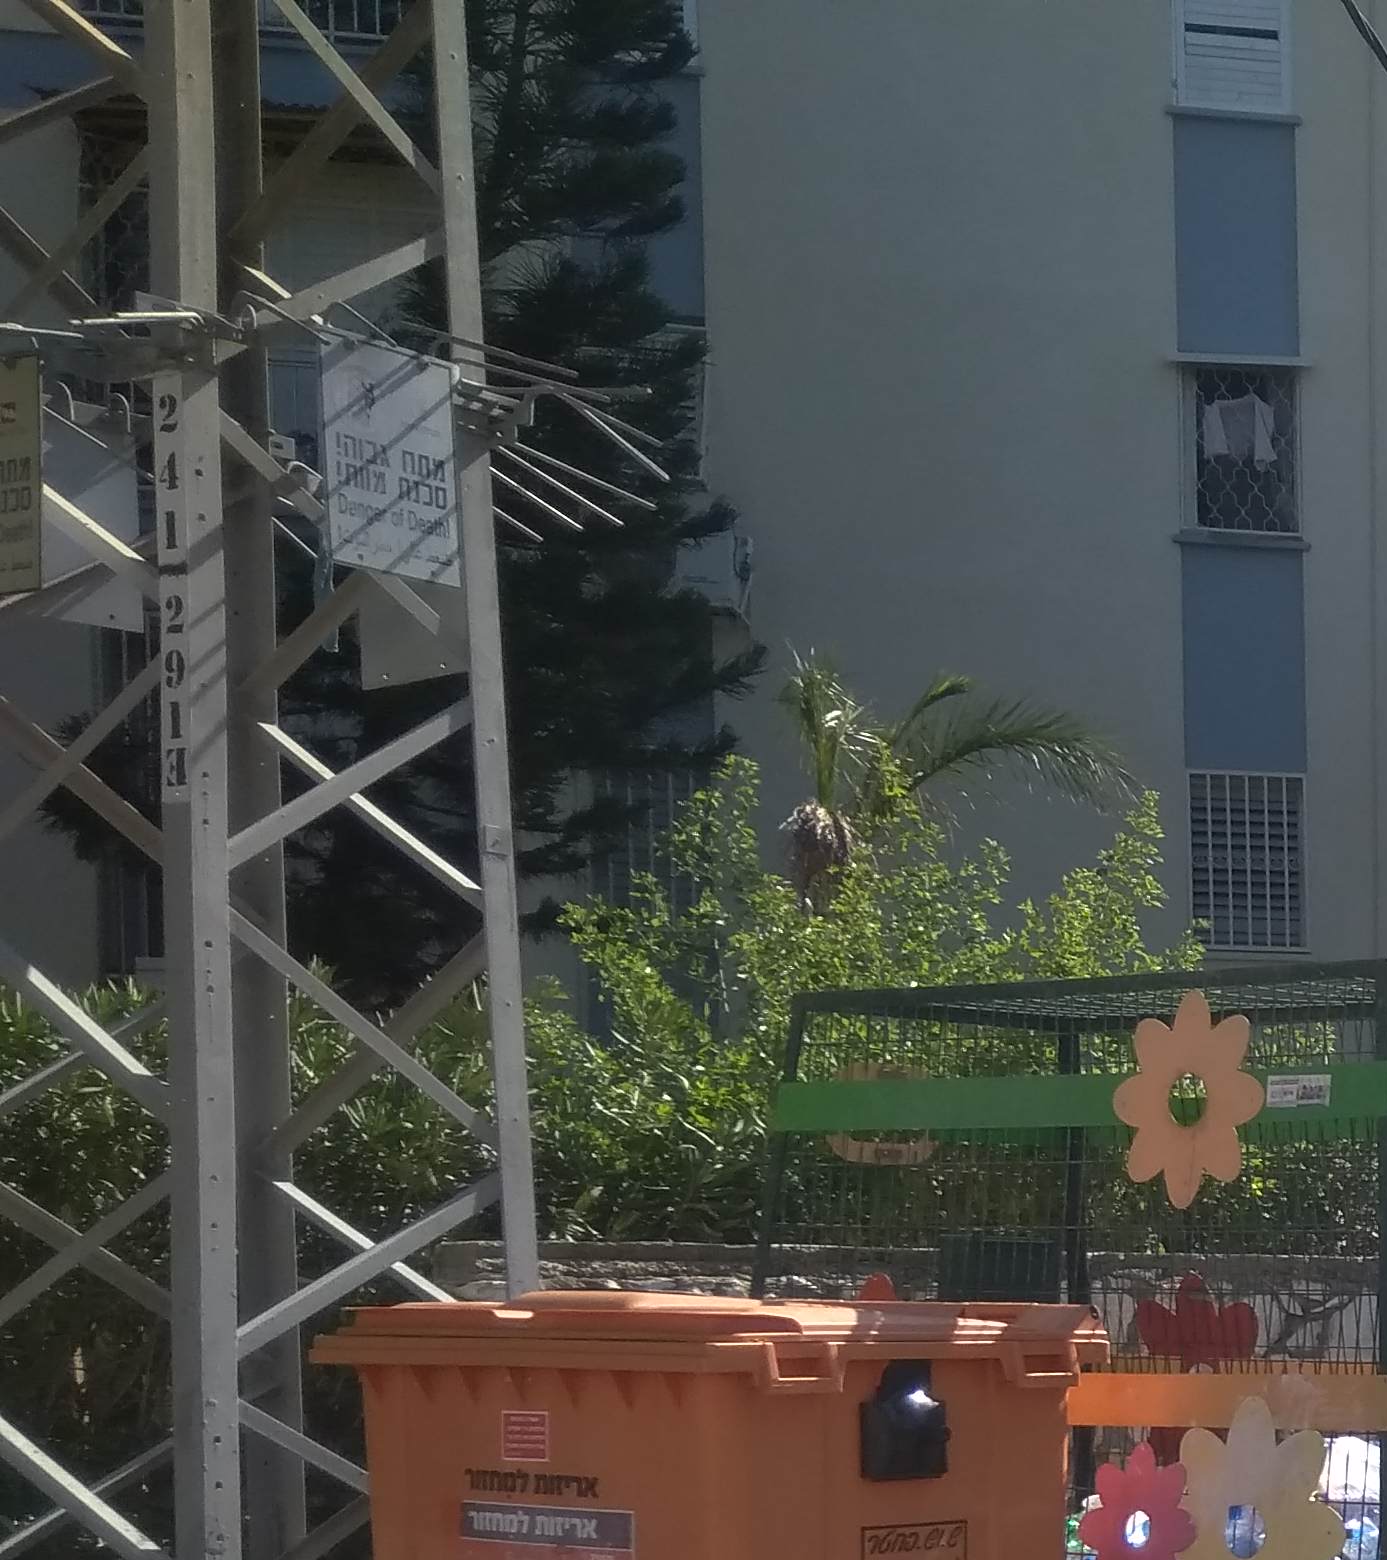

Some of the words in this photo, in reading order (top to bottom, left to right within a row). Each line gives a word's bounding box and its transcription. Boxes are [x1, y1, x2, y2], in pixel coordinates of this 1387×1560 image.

[335, 432, 390, 468] גבוה!
[402, 450, 446, 482] מתח
[336, 460, 387, 495] מוות!
[398, 476, 447, 510] סכנת
[337, 492, 389, 526] Danger
[391, 508, 405, 528] of
[408, 509, 450, 538] Death!
[534, 1473, 599, 1498] אריזות
[535, 1514, 598, 1539] אריזות
